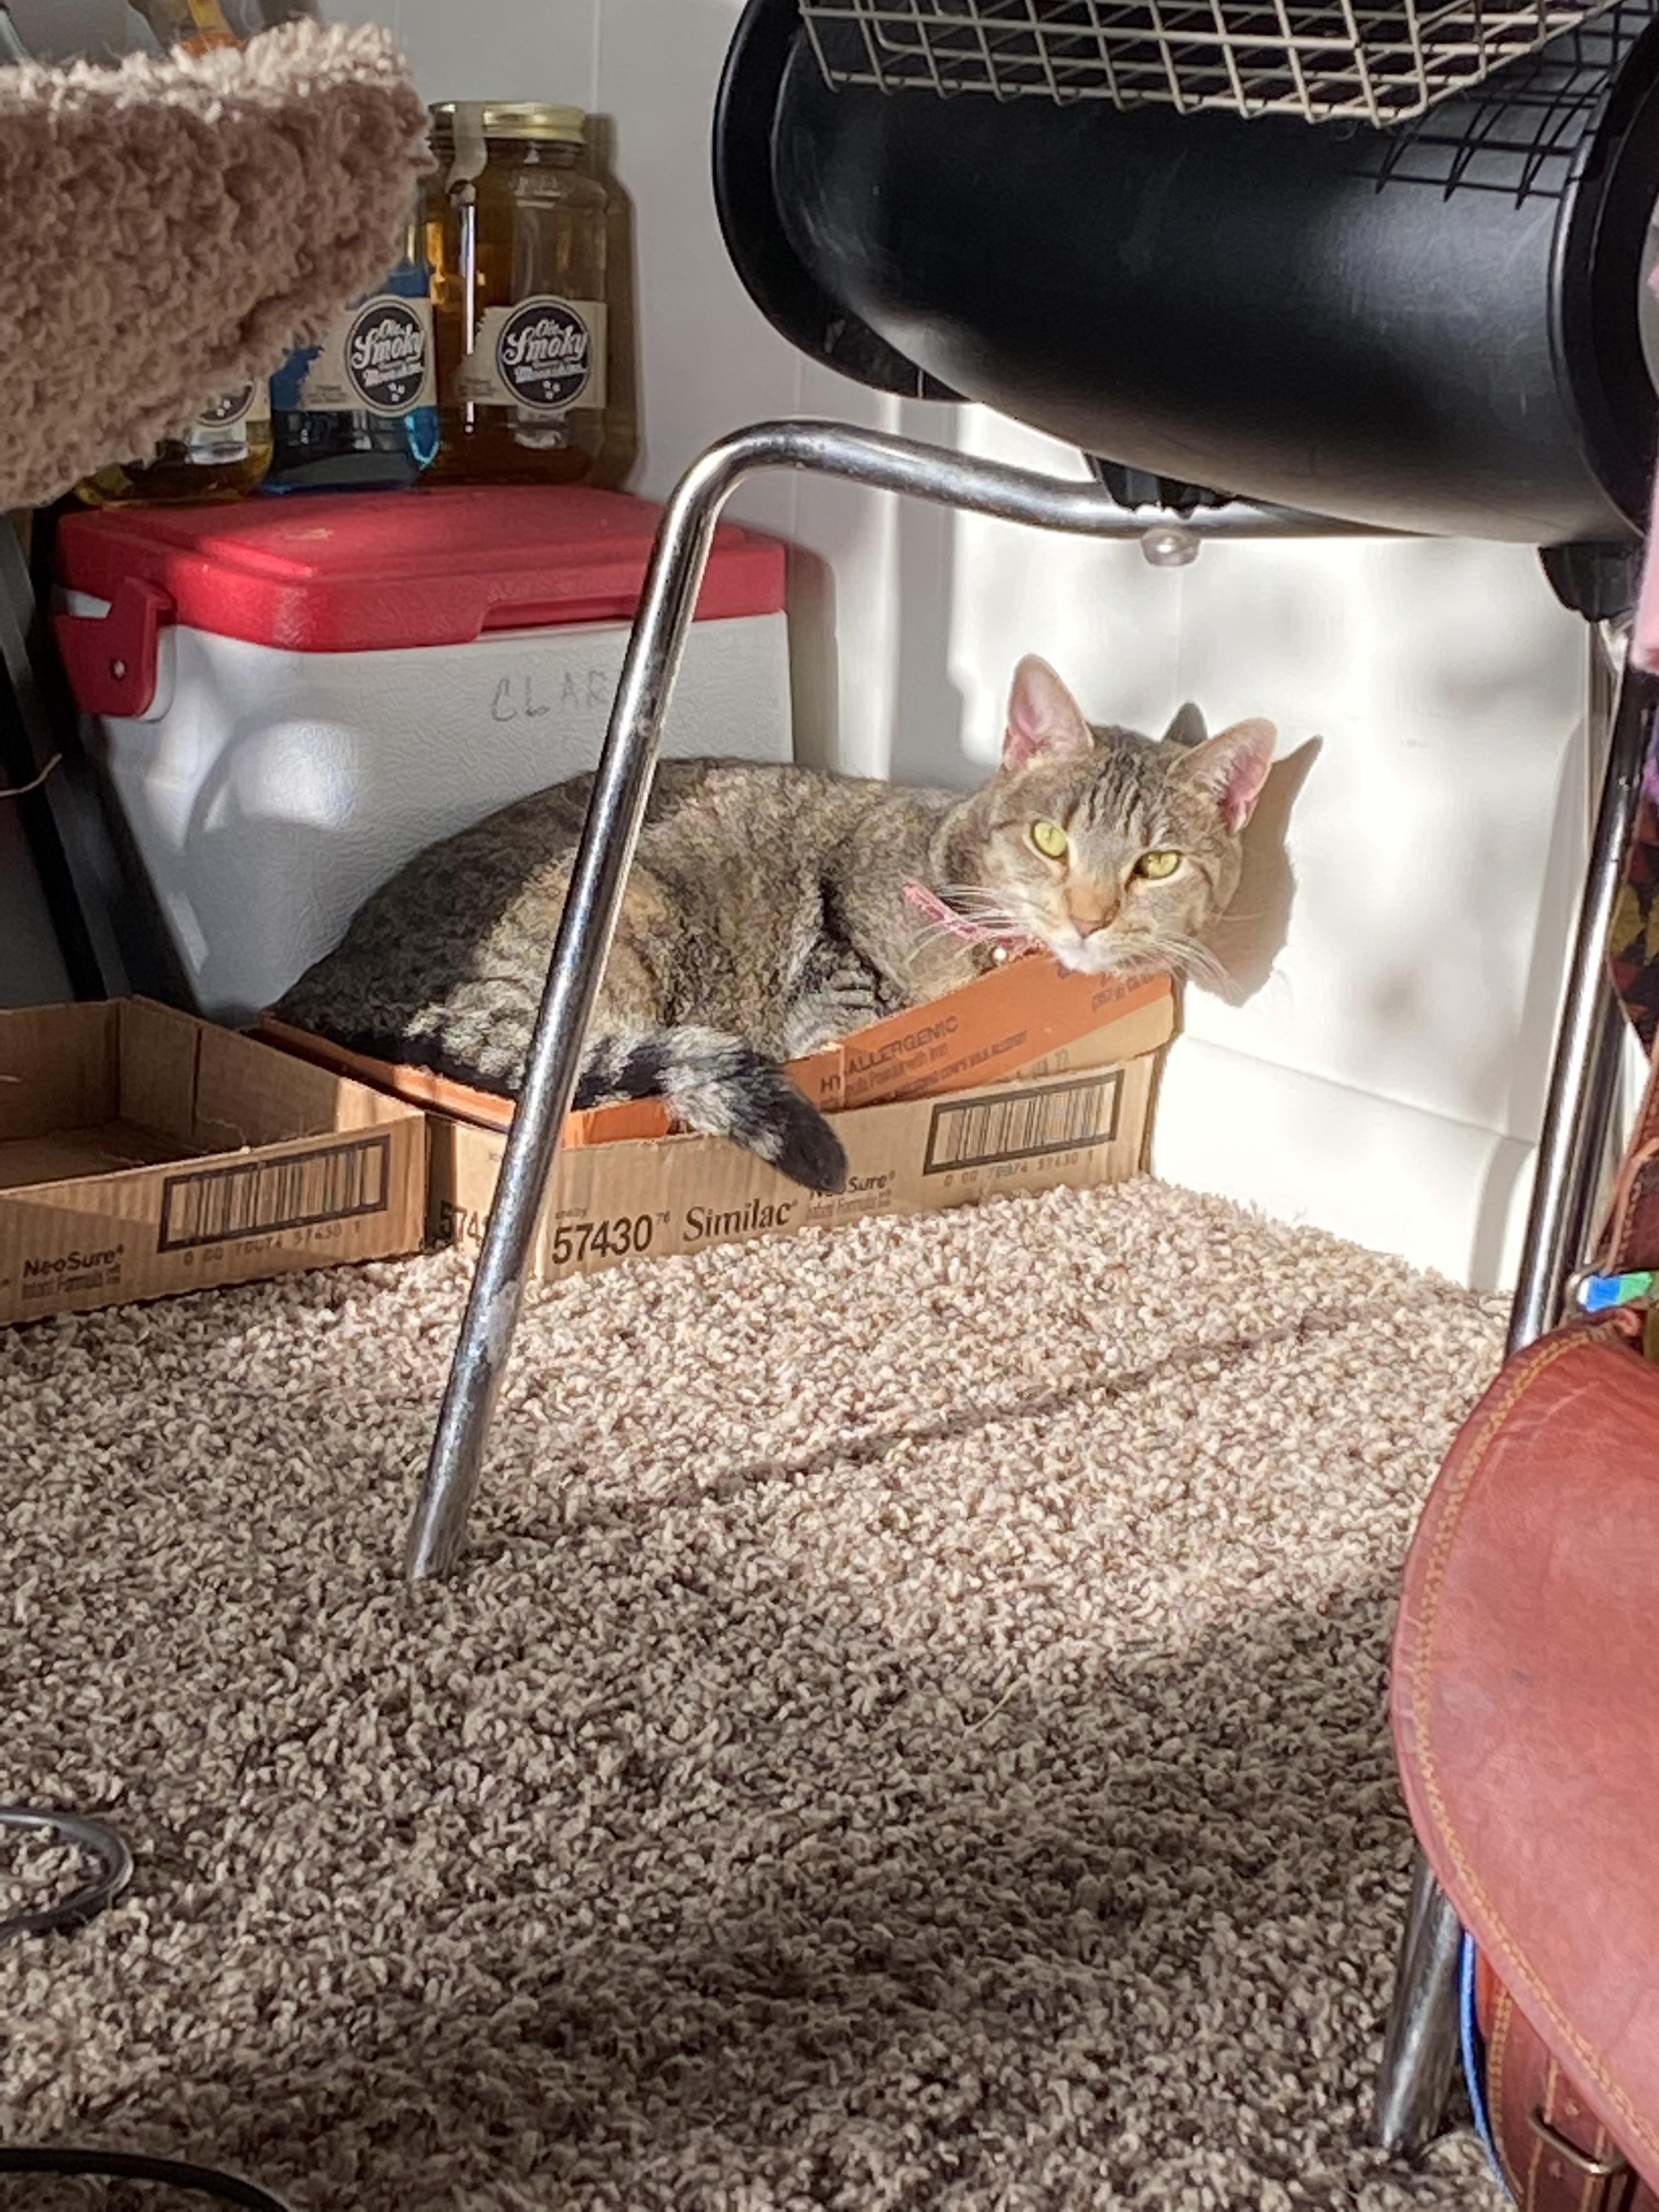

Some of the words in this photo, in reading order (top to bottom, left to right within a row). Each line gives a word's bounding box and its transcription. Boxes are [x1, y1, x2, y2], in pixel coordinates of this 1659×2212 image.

[352, 323, 426, 370] Smoky
[503, 325, 588, 366] Smoky
[552, 1214, 653, 1265] 57430
[682, 1198, 793, 1242] Similac
